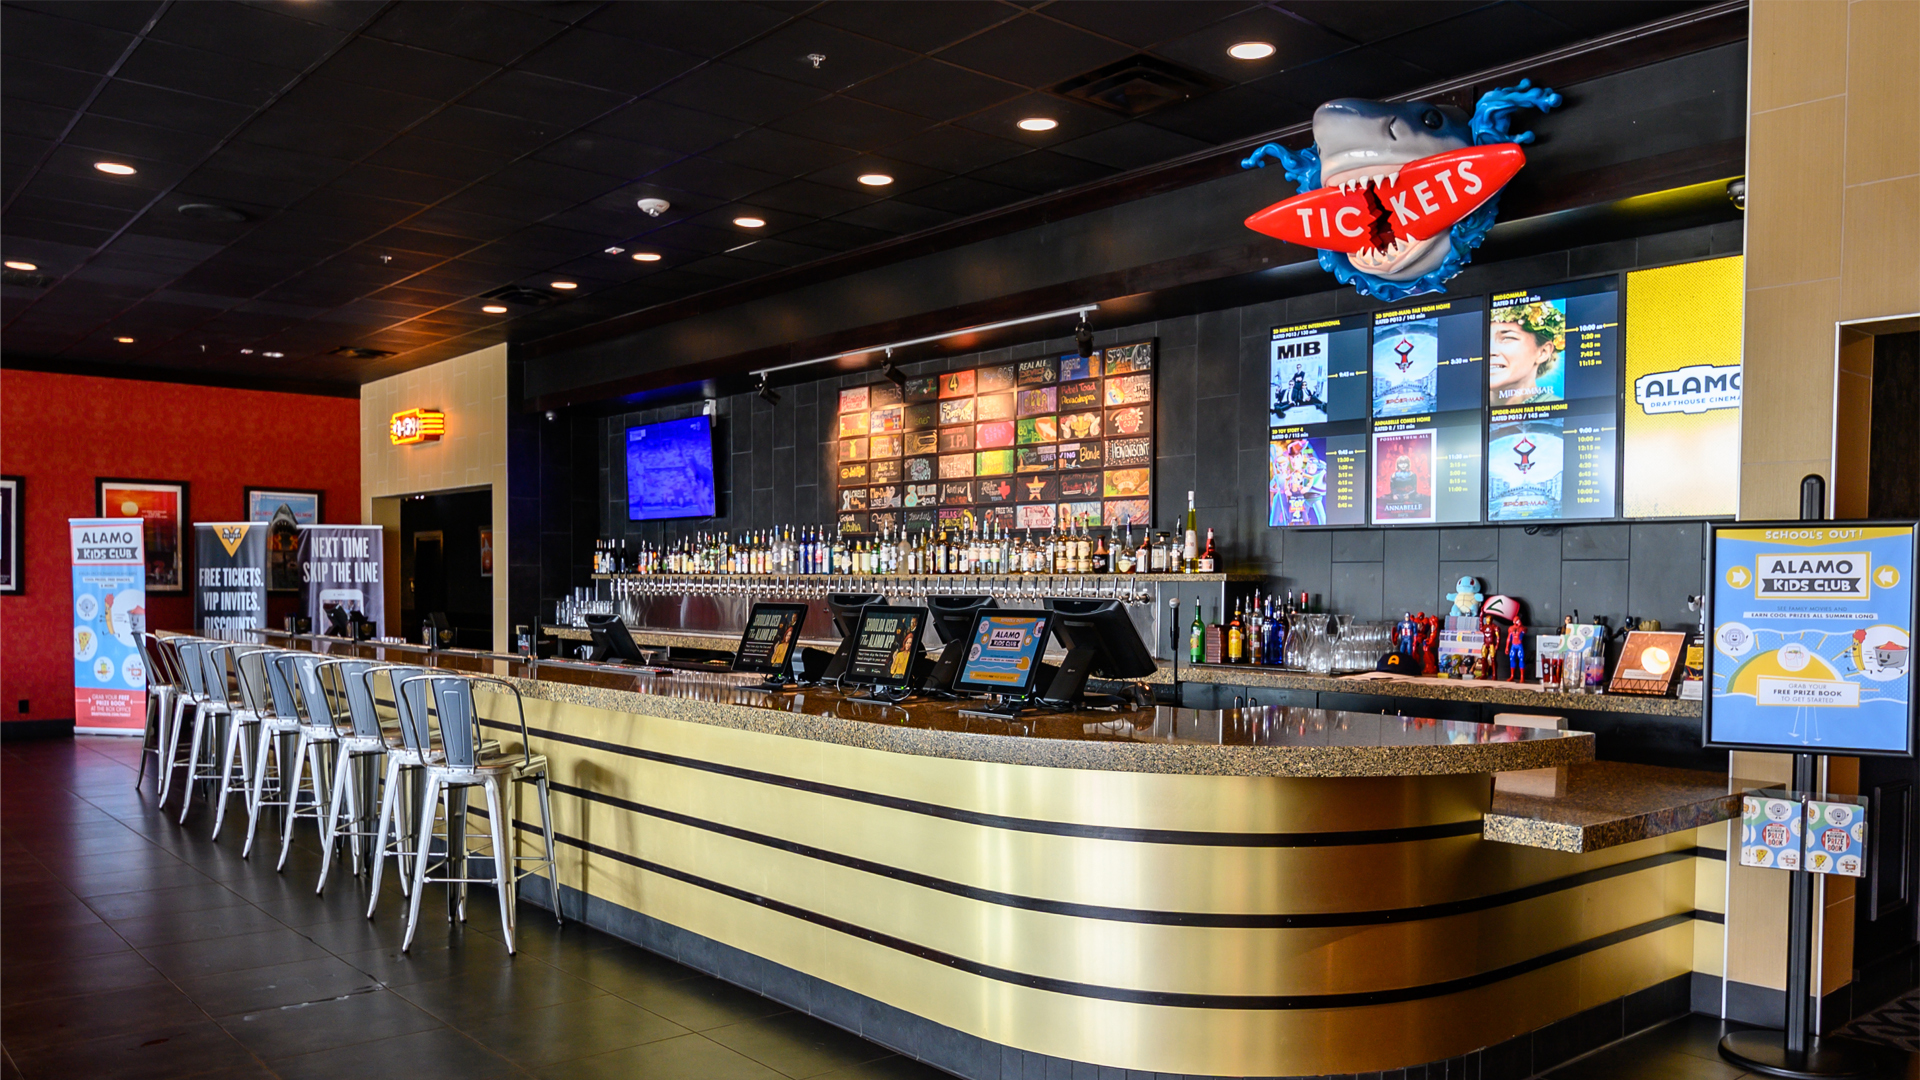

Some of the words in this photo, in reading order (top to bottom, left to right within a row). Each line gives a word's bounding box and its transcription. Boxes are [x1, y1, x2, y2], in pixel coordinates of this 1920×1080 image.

[1296, 161, 1481, 238] TICKETS
[1493, 291, 1527, 301] MIDSOMMAR
[1308, 320, 1340, 330] INTERNATIONAL
[1579, 324, 1595, 332] 10:00
[1278, 341, 1321, 360] MIB
[1019, 362, 1035, 371] REAL
[1061, 358, 1080, 370] MOSAIC
[1061, 370, 1071, 381] IPA
[1499, 386, 1554, 399] MIDSOMMAR
[1651, 398, 1706, 408] DRAFTHOUSE
[1492, 408, 1523, 416] SPIDER-MAN
[950, 434, 968, 448] IPA
[1080, 446, 1100, 462] Blonde
[922, 497, 936, 506] SOUR
[82, 532, 133, 544] ALAMO
[84, 548, 106, 560] KIDS
[109, 547, 132, 559] CLUB
[311, 537, 338, 558] NEXT
[341, 537, 369, 558] TIME
[303, 562, 328, 584] SKIP
[332, 562, 352, 583] THE
[355, 562, 378, 583] LINE
[1771, 560, 1853, 575] ALAMO
[199, 567, 221, 587] FREE
[222, 568, 264, 587] TICKETS.
[1773, 579, 1809, 592] KIDS
[1814, 580, 1851, 592] CLUB
[204, 591, 220, 611] VIP
[221, 591, 260, 612] INVITES.
[860, 634, 869, 646] The
[995, 631, 1021, 639] ALAMO
[1387, 654, 1400, 665] A
